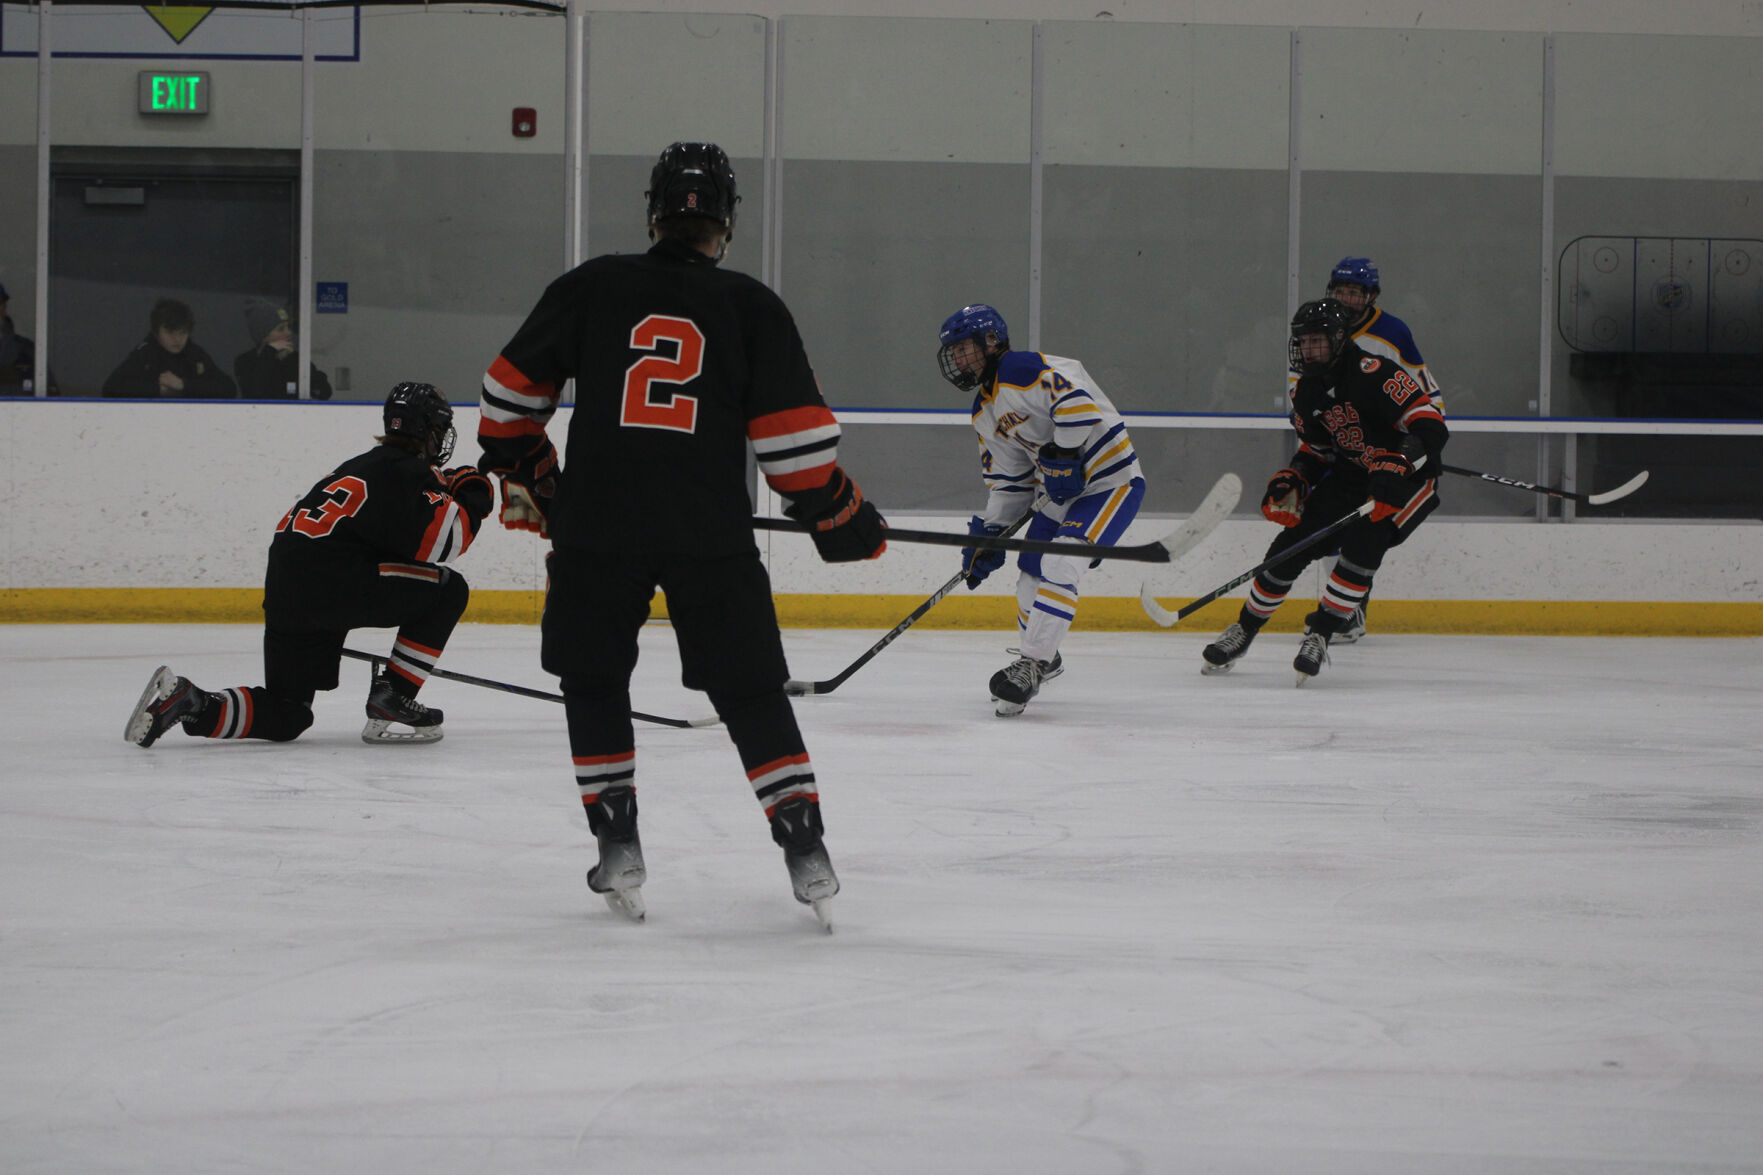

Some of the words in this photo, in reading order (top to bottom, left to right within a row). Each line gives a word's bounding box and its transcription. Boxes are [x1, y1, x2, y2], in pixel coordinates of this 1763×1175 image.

[152, 76, 201, 110] EXIT
[687, 193, 698, 208] 2
[619, 313, 706, 435] 2
[1041, 371, 1074, 403] 14
[1382, 370, 1420, 406] 22
[1335, 426, 1366, 452] 22
[1480, 472, 1536, 490] CCM
